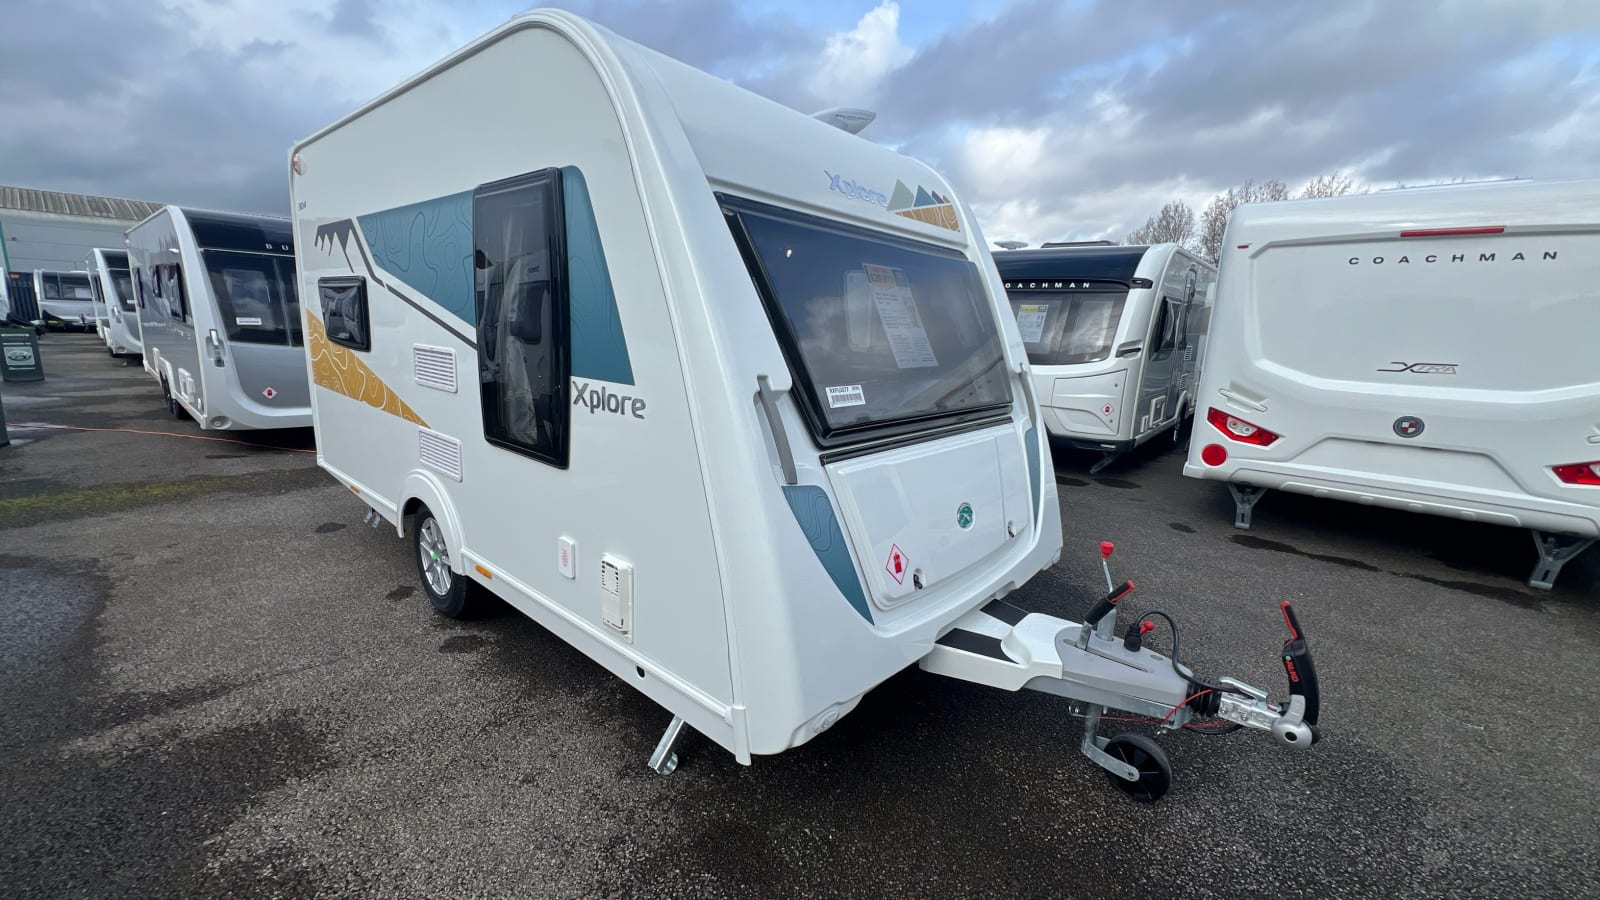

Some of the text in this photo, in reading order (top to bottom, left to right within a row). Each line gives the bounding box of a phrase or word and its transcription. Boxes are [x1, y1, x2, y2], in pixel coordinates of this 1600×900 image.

[823, 169, 888, 207] Xplore
[1348, 251, 1558, 265] COACHMAN
[572, 380, 646, 420] Xplore
